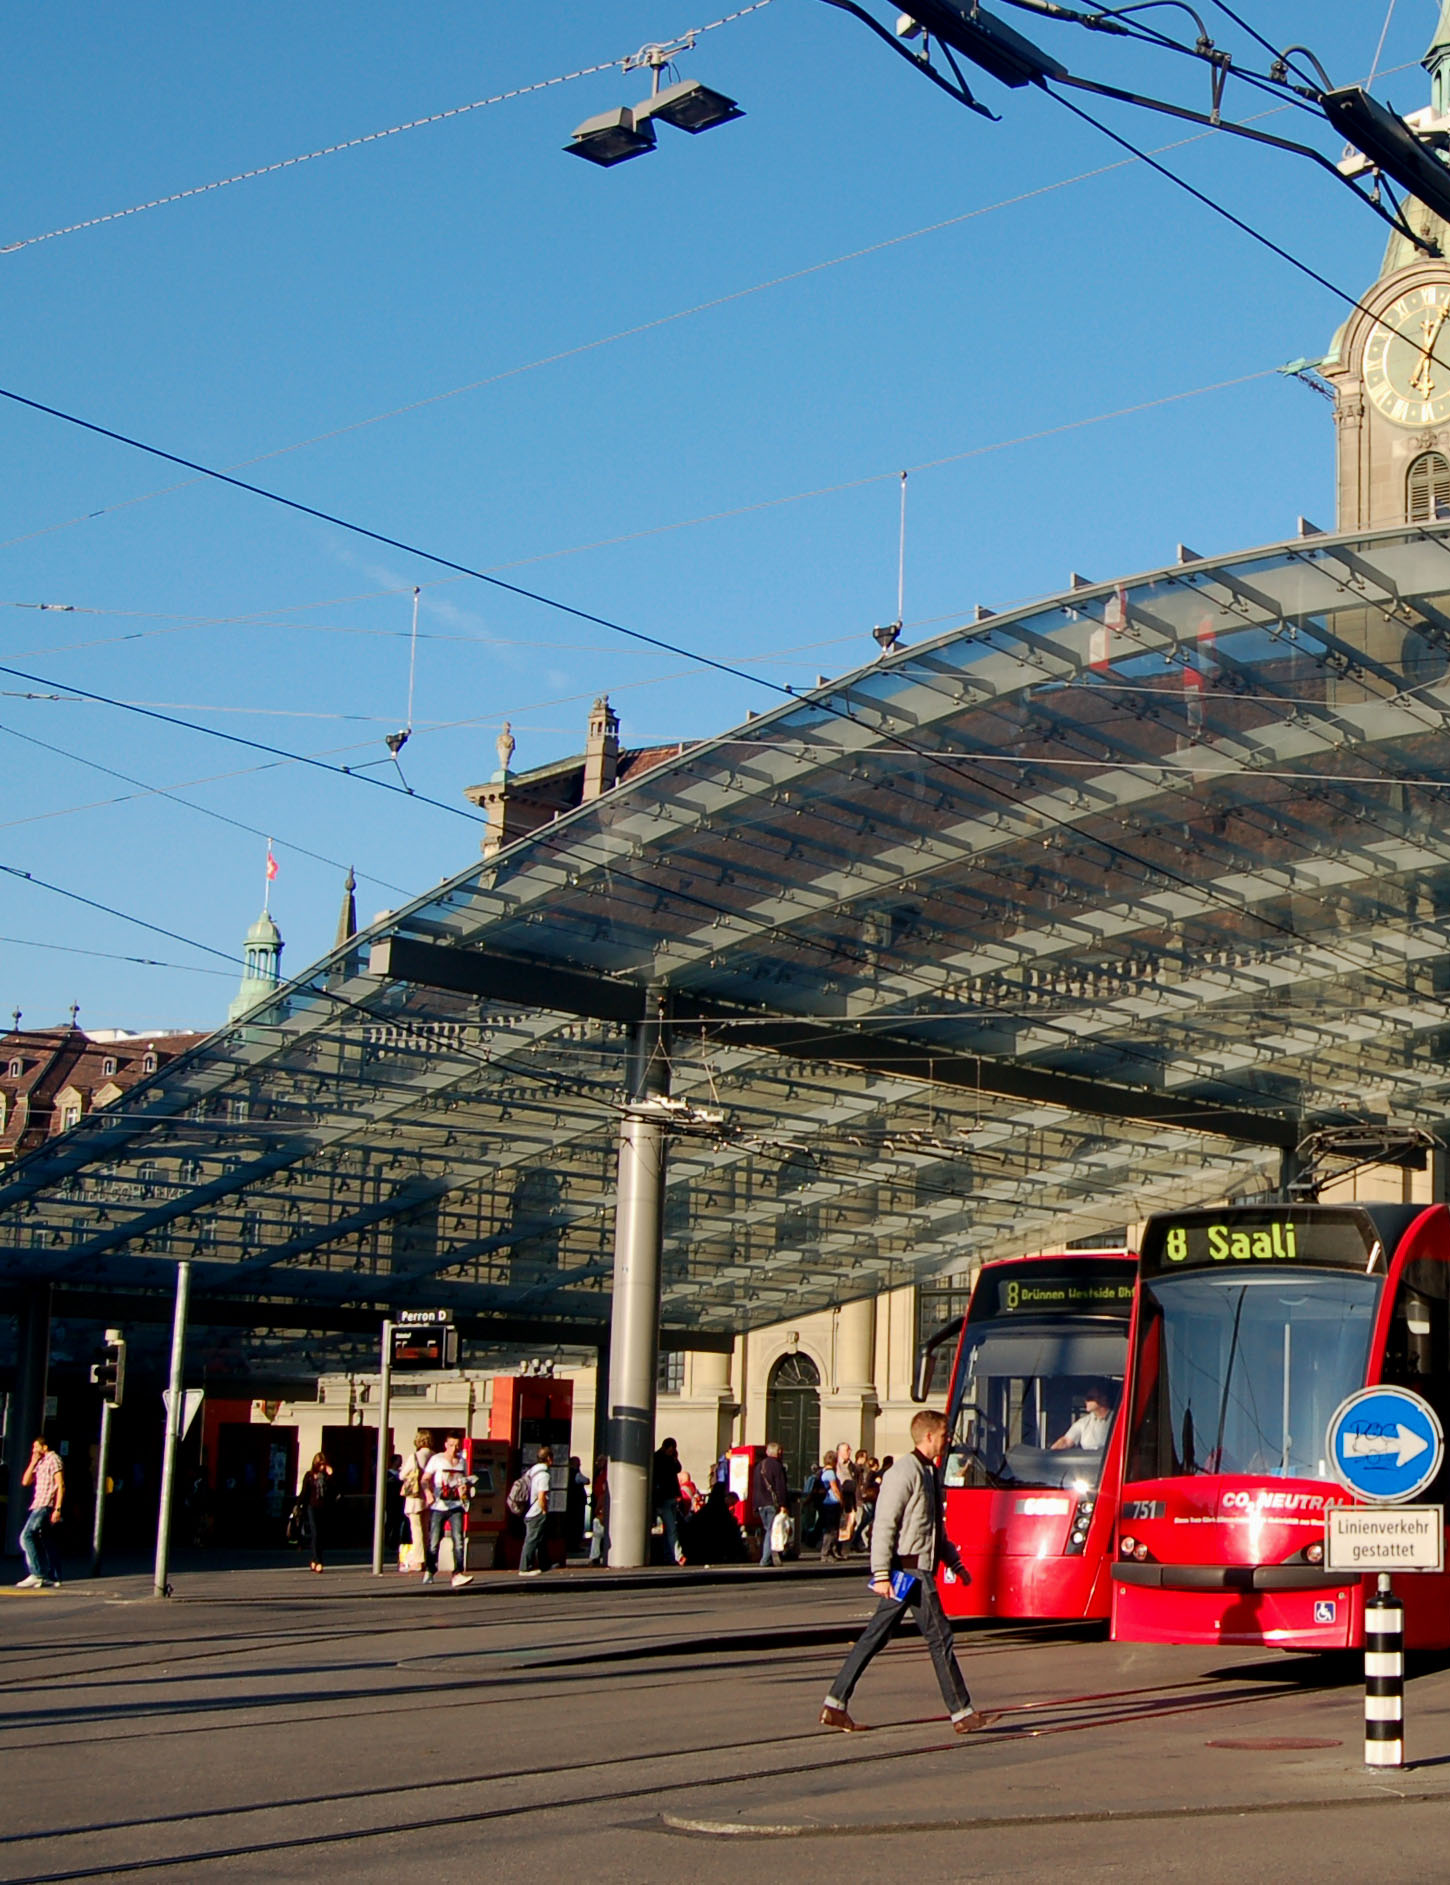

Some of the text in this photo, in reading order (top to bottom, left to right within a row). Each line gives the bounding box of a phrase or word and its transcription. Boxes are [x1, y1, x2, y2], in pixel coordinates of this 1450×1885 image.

[1167, 1222, 1296, 1261] 8 Saali
[1008, 1281, 1019, 1308] 8
[1021, 1288, 1065, 1300] Brünnen
[401, 1309, 447, 1322] Perron D
[1132, 1500, 1157, 1519] 751
[1337, 1519, 1429, 1535] Linienverkehr
[1352, 1544, 1415, 1561] gestattet
